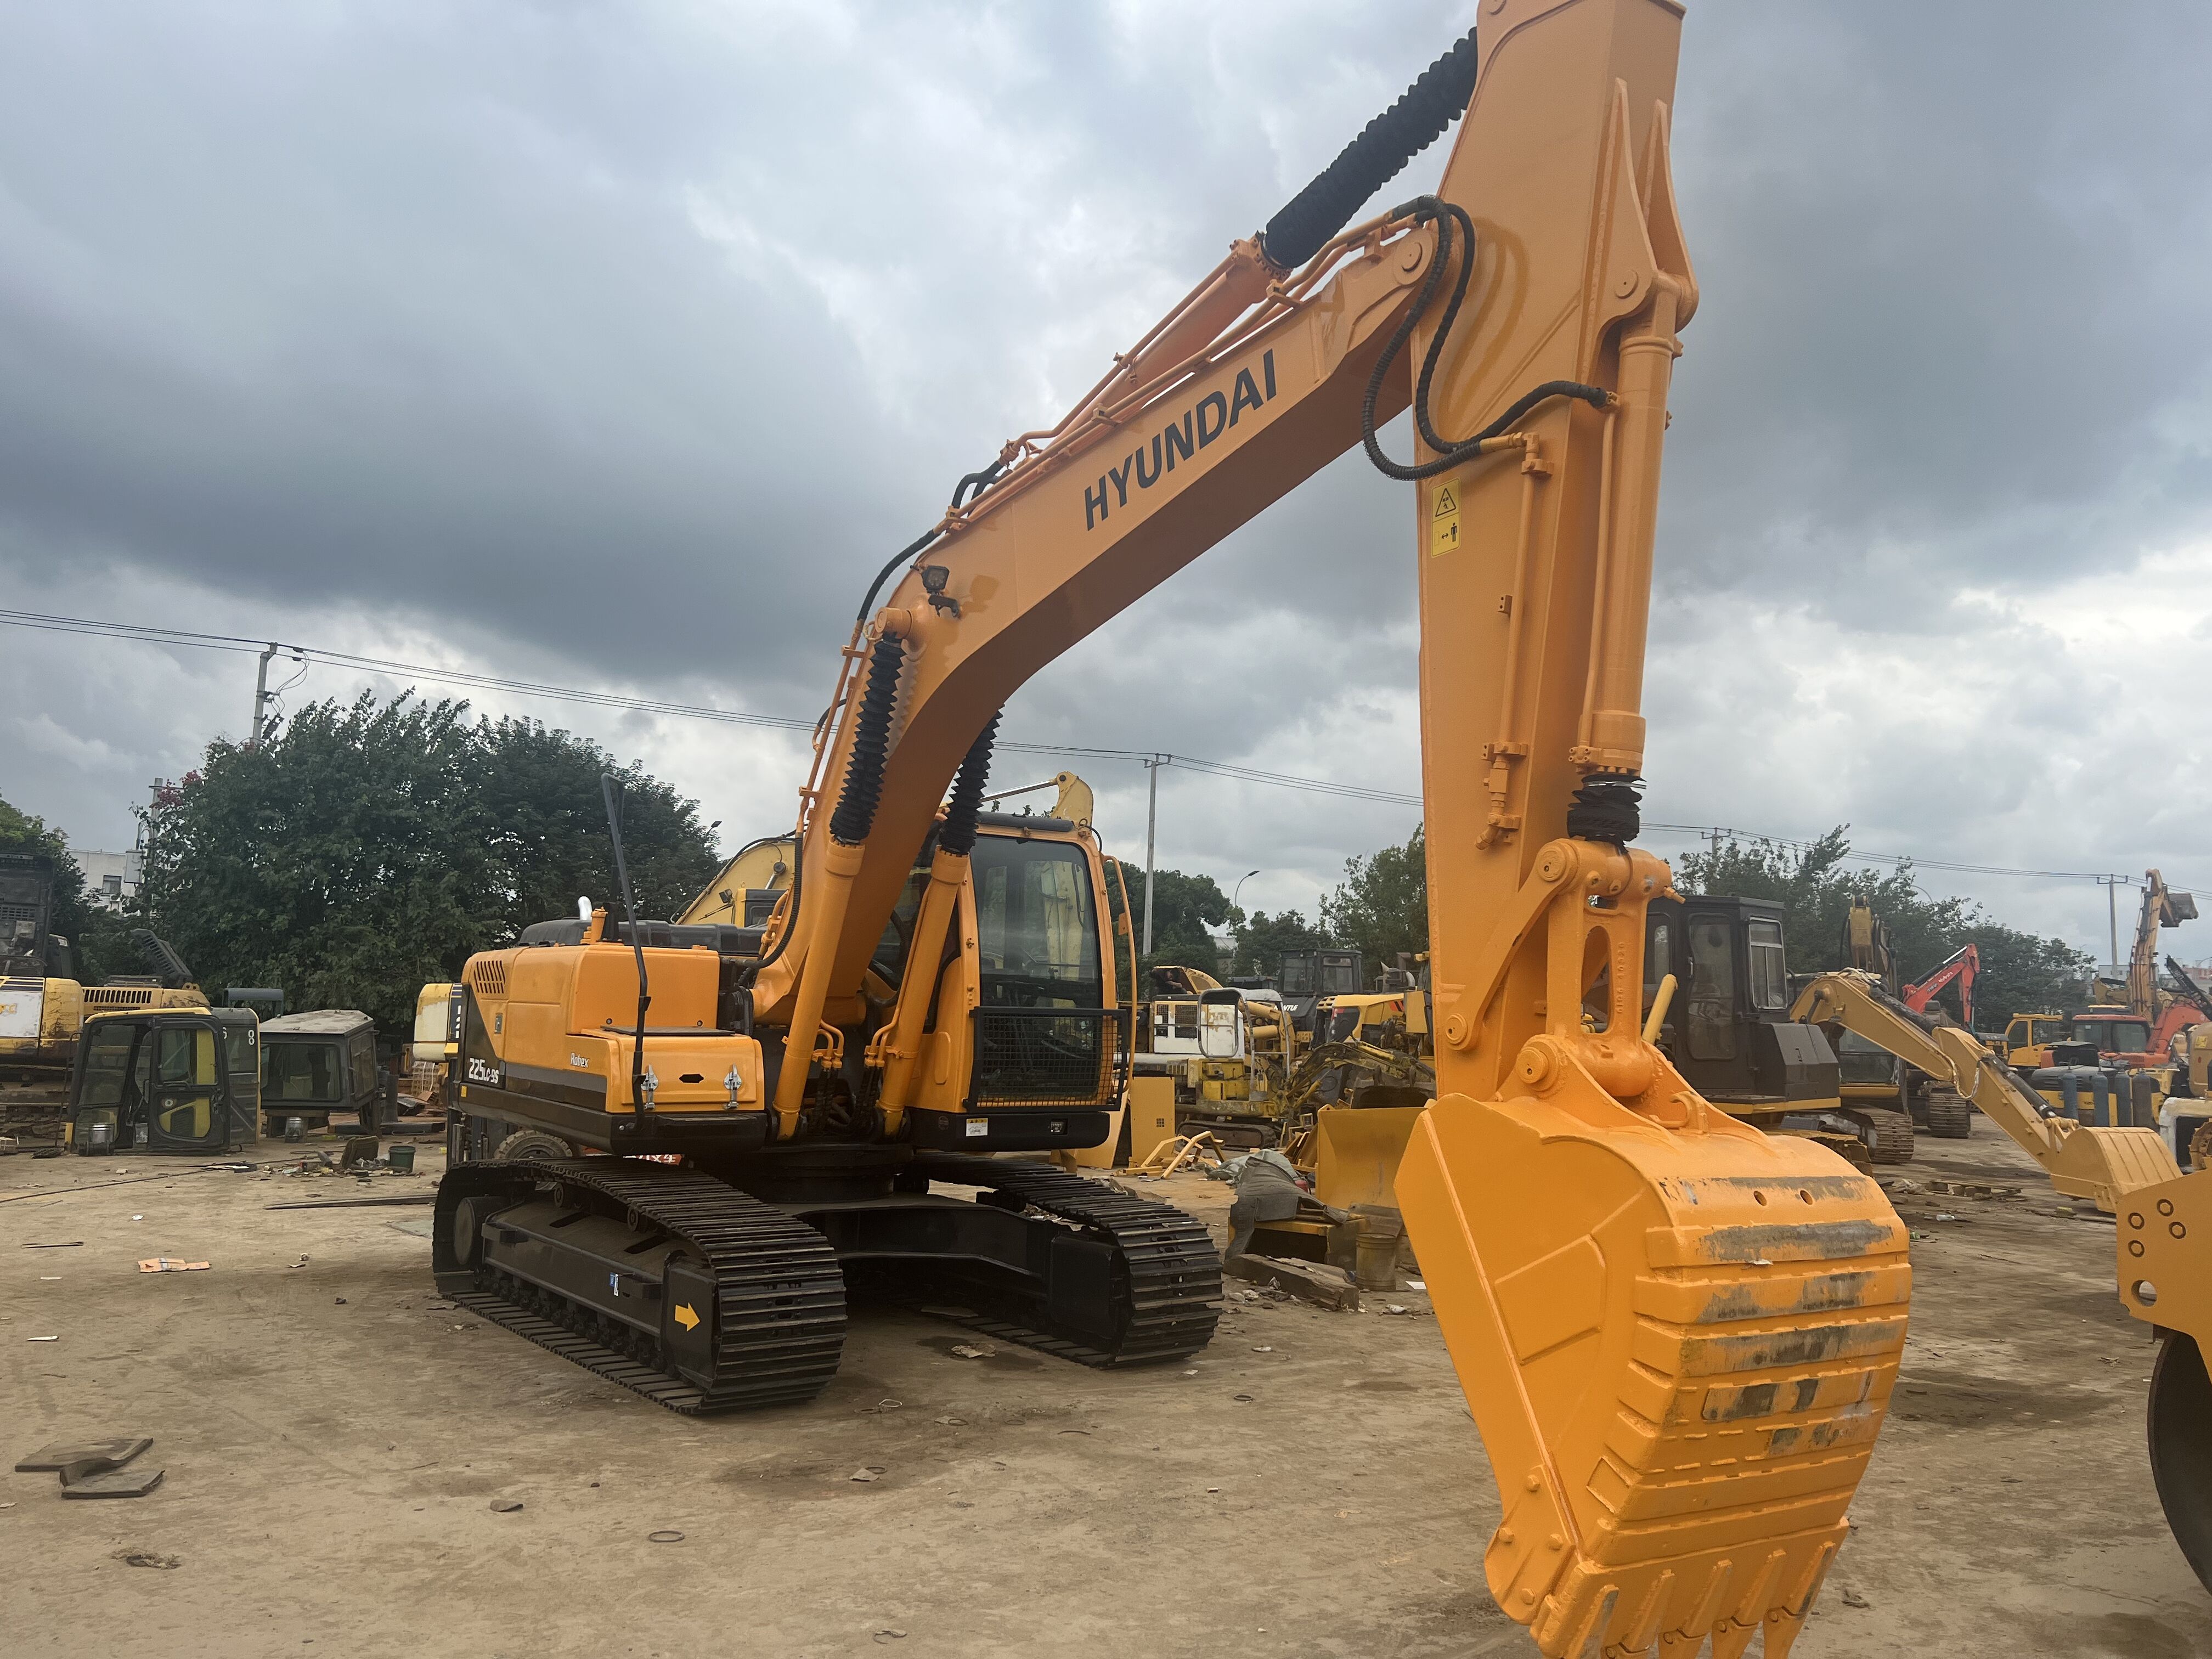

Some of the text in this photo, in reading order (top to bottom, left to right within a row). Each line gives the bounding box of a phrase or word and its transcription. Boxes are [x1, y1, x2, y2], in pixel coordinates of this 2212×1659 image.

[1084, 348, 1277, 532] HYUNDAI
[248, 1029, 255, 1046] 8
[571, 1052, 589, 1068] Robex
